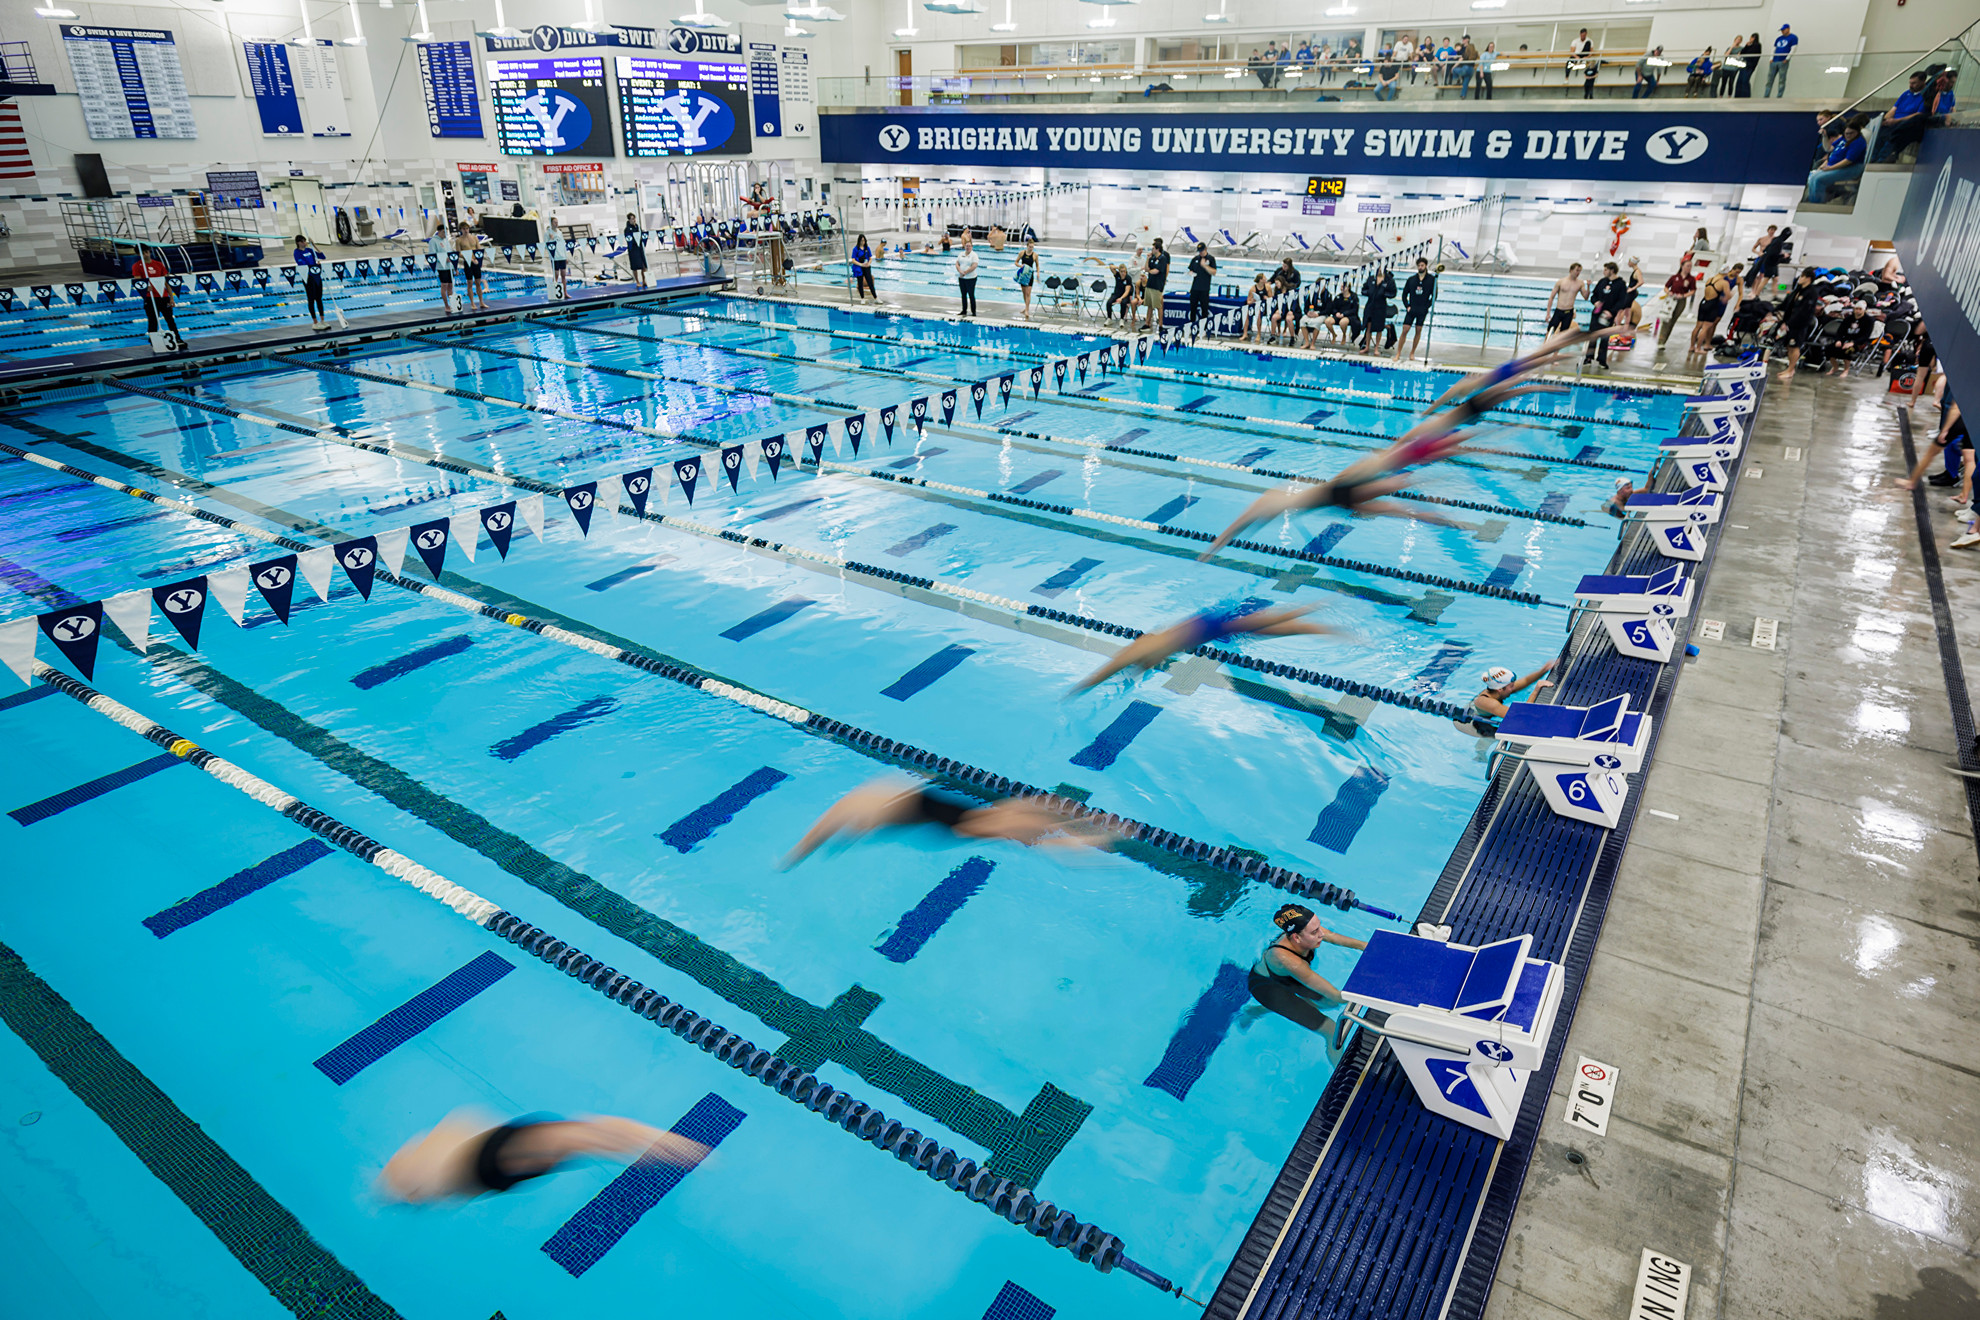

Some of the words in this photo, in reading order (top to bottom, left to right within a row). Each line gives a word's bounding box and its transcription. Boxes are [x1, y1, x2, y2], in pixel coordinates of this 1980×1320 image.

[494, 38, 530, 48] SWIM
[537, 28, 554, 50] Y
[563, 30, 596, 45] DIVE
[619, 29, 666, 46] SWIM
[673, 30, 692, 52] Y
[702, 36, 735, 51] DIVE
[419, 47, 438, 123] OLYMPIANS
[918, 127, 1038, 151] BRIGHAM
[1046, 127, 1142, 154] YOUNG
[1151, 127, 1354, 156] UNIVERSITY
[1363, 128, 1475, 160] SWIM
[1486, 128, 1513, 160] &
[1524, 129, 1630, 160] DIVE
[1308, 180, 1343, 195] 21:42
[555, 284, 563, 300] 3
[456, 296, 462, 310] 3
[1164, 310, 1186, 319] SWIM
[164, 332, 176, 350] 3
[1720, 420, 1730, 431] 2
[1698, 466, 1708, 480] 3
[1672, 532, 1685, 546] 4
[1632, 626, 1647, 644] 5
[1568, 780, 1586, 801] 6
[1445, 1068, 1468, 1095] 7
[1640, 1256, 1682, 1320] NING
